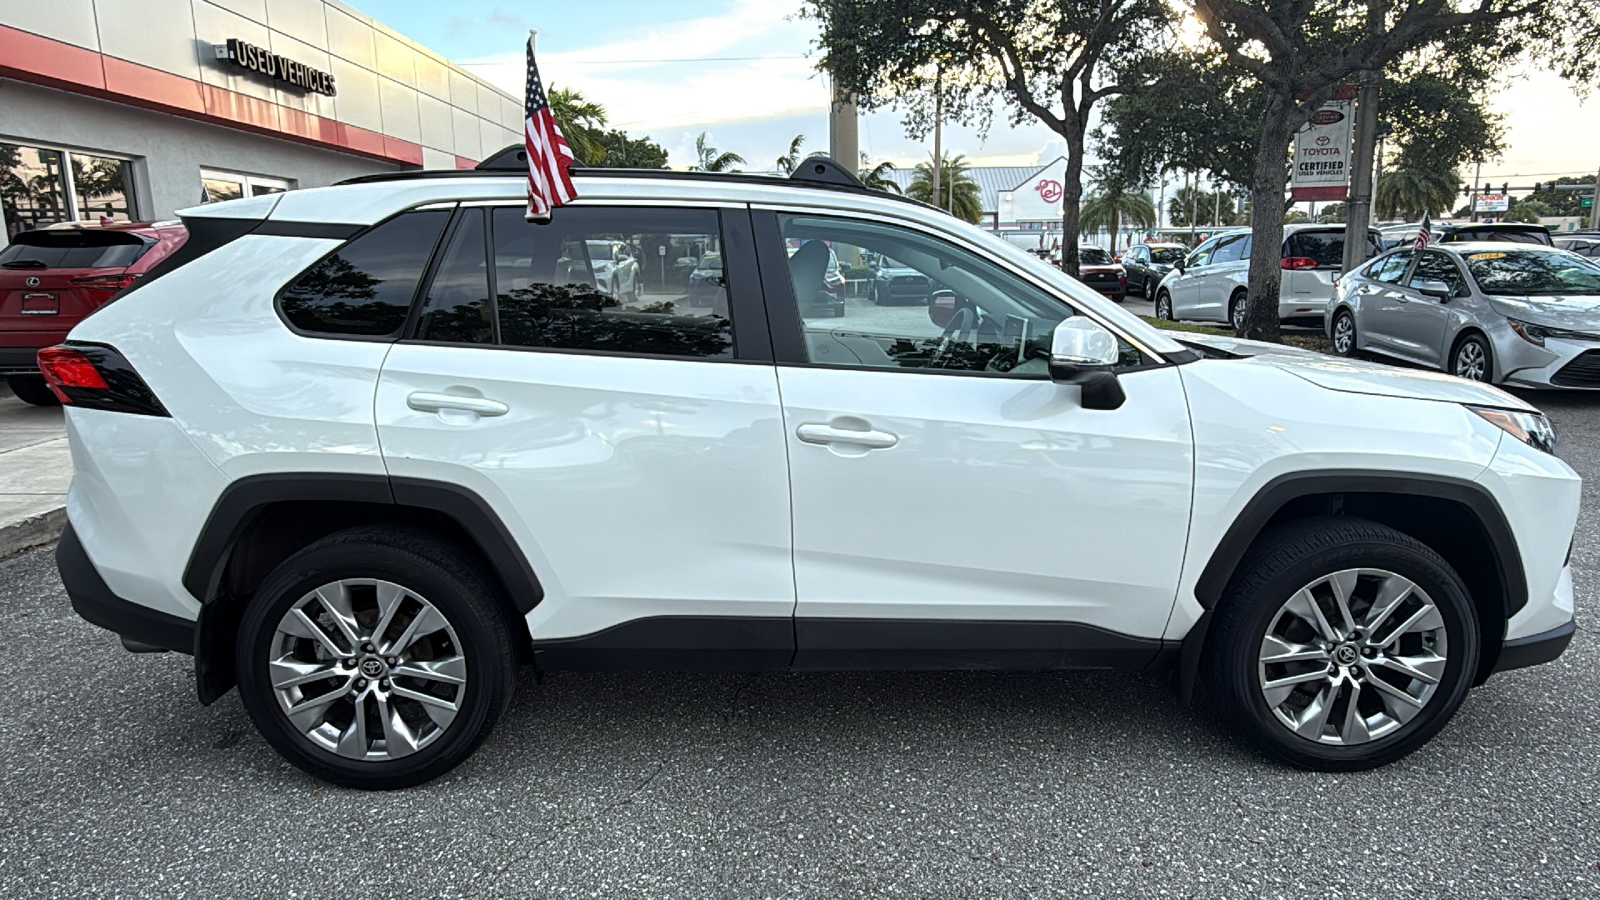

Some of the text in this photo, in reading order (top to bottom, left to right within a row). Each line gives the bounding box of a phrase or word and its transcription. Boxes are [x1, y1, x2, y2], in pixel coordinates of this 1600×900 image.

[235, 40, 337, 97] USED VEHICLES
[1302, 147, 1340, 156] TOYOTA
[1299, 161, 1344, 171] CERTIFIED
